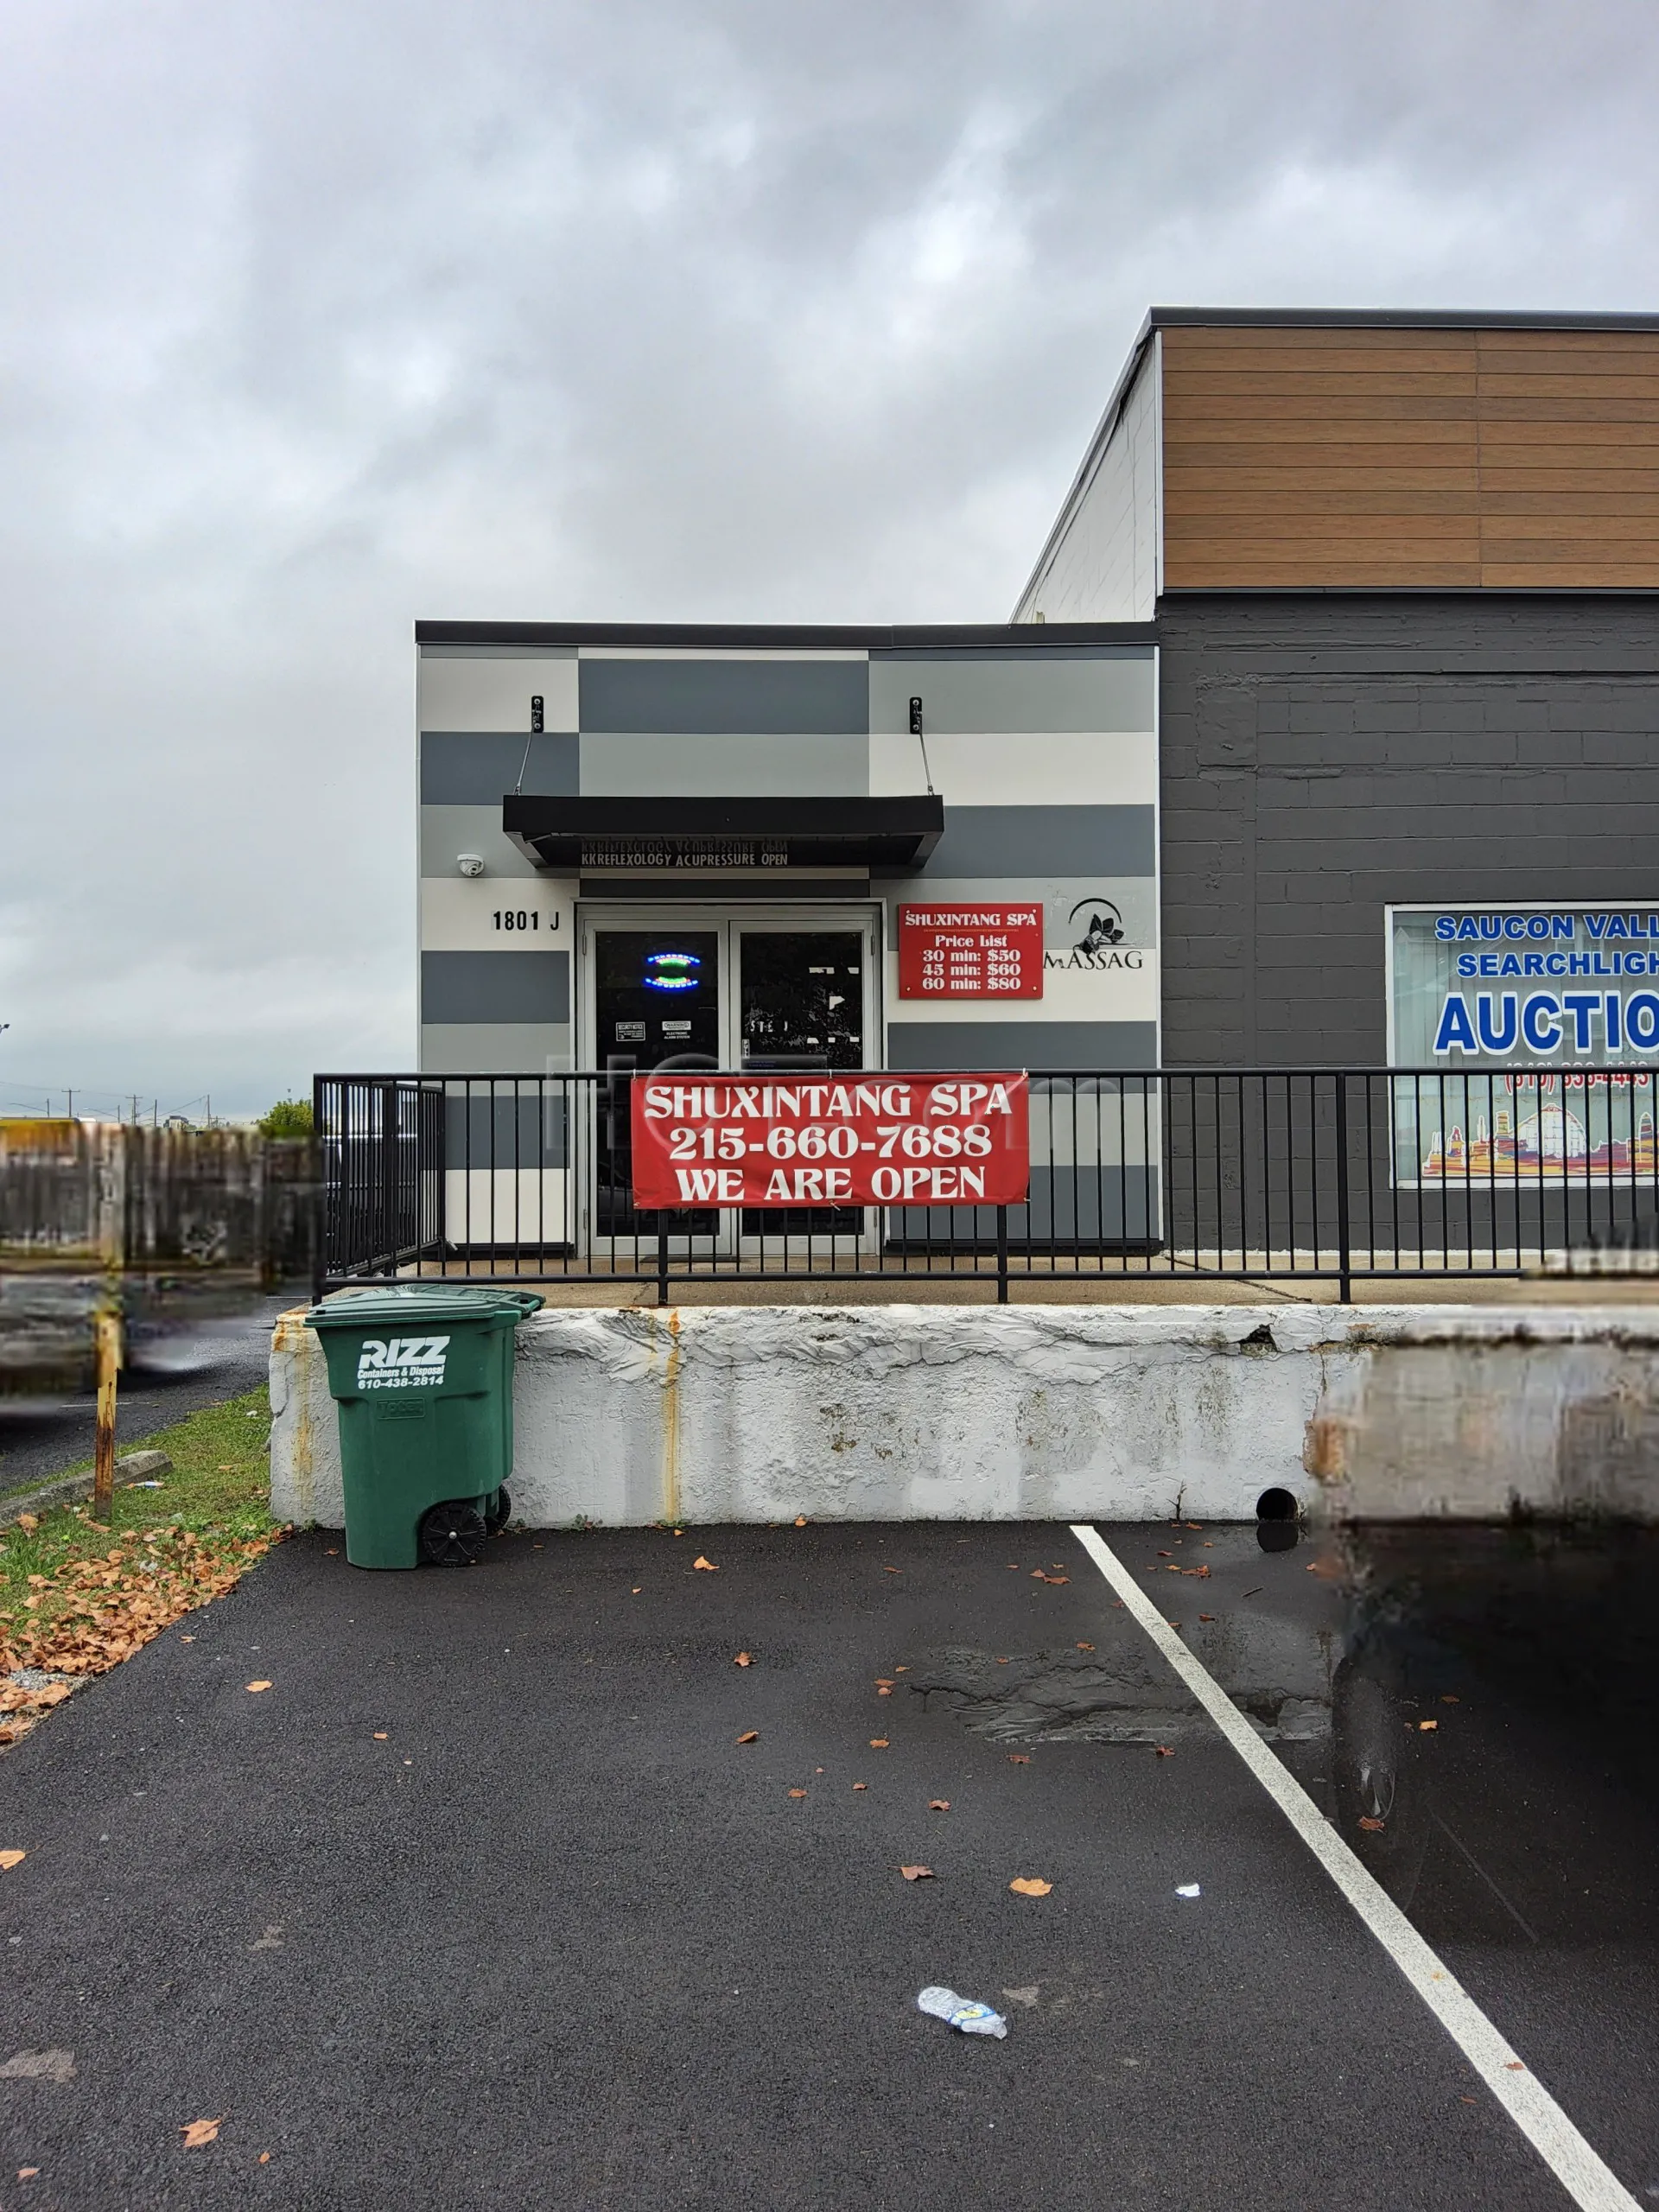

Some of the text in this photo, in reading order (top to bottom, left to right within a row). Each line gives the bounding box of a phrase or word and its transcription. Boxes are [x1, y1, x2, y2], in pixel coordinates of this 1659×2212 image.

[676, 854, 755, 866] ACUPRESSURE
[761, 854, 788, 865] OPEN
[493, 910, 559, 931] 1801 J
[905, 912, 1037, 926] SHUXINTANG SPA
[1434, 914, 1659, 941] SAUCON VALL
[935, 934, 1007, 947] Price List
[922, 948, 1021, 963] 30 min: $50
[923, 962, 1021, 976] 45 min: $60
[922, 976, 1021, 990] 60 min: $80
[1433, 989, 1659, 1055] AUCTIO
[645, 1083, 1013, 1119] SHUXINTANG SPA
[669, 1124, 992, 1160] 215-660-7688
[676, 1166, 986, 1201] WE ARE OPEN
[359, 1336, 450, 1369] RIZZ
[357, 1365, 445, 1379] Containers & Disposal
[358, 1376, 444, 1389] 610-438-2814
